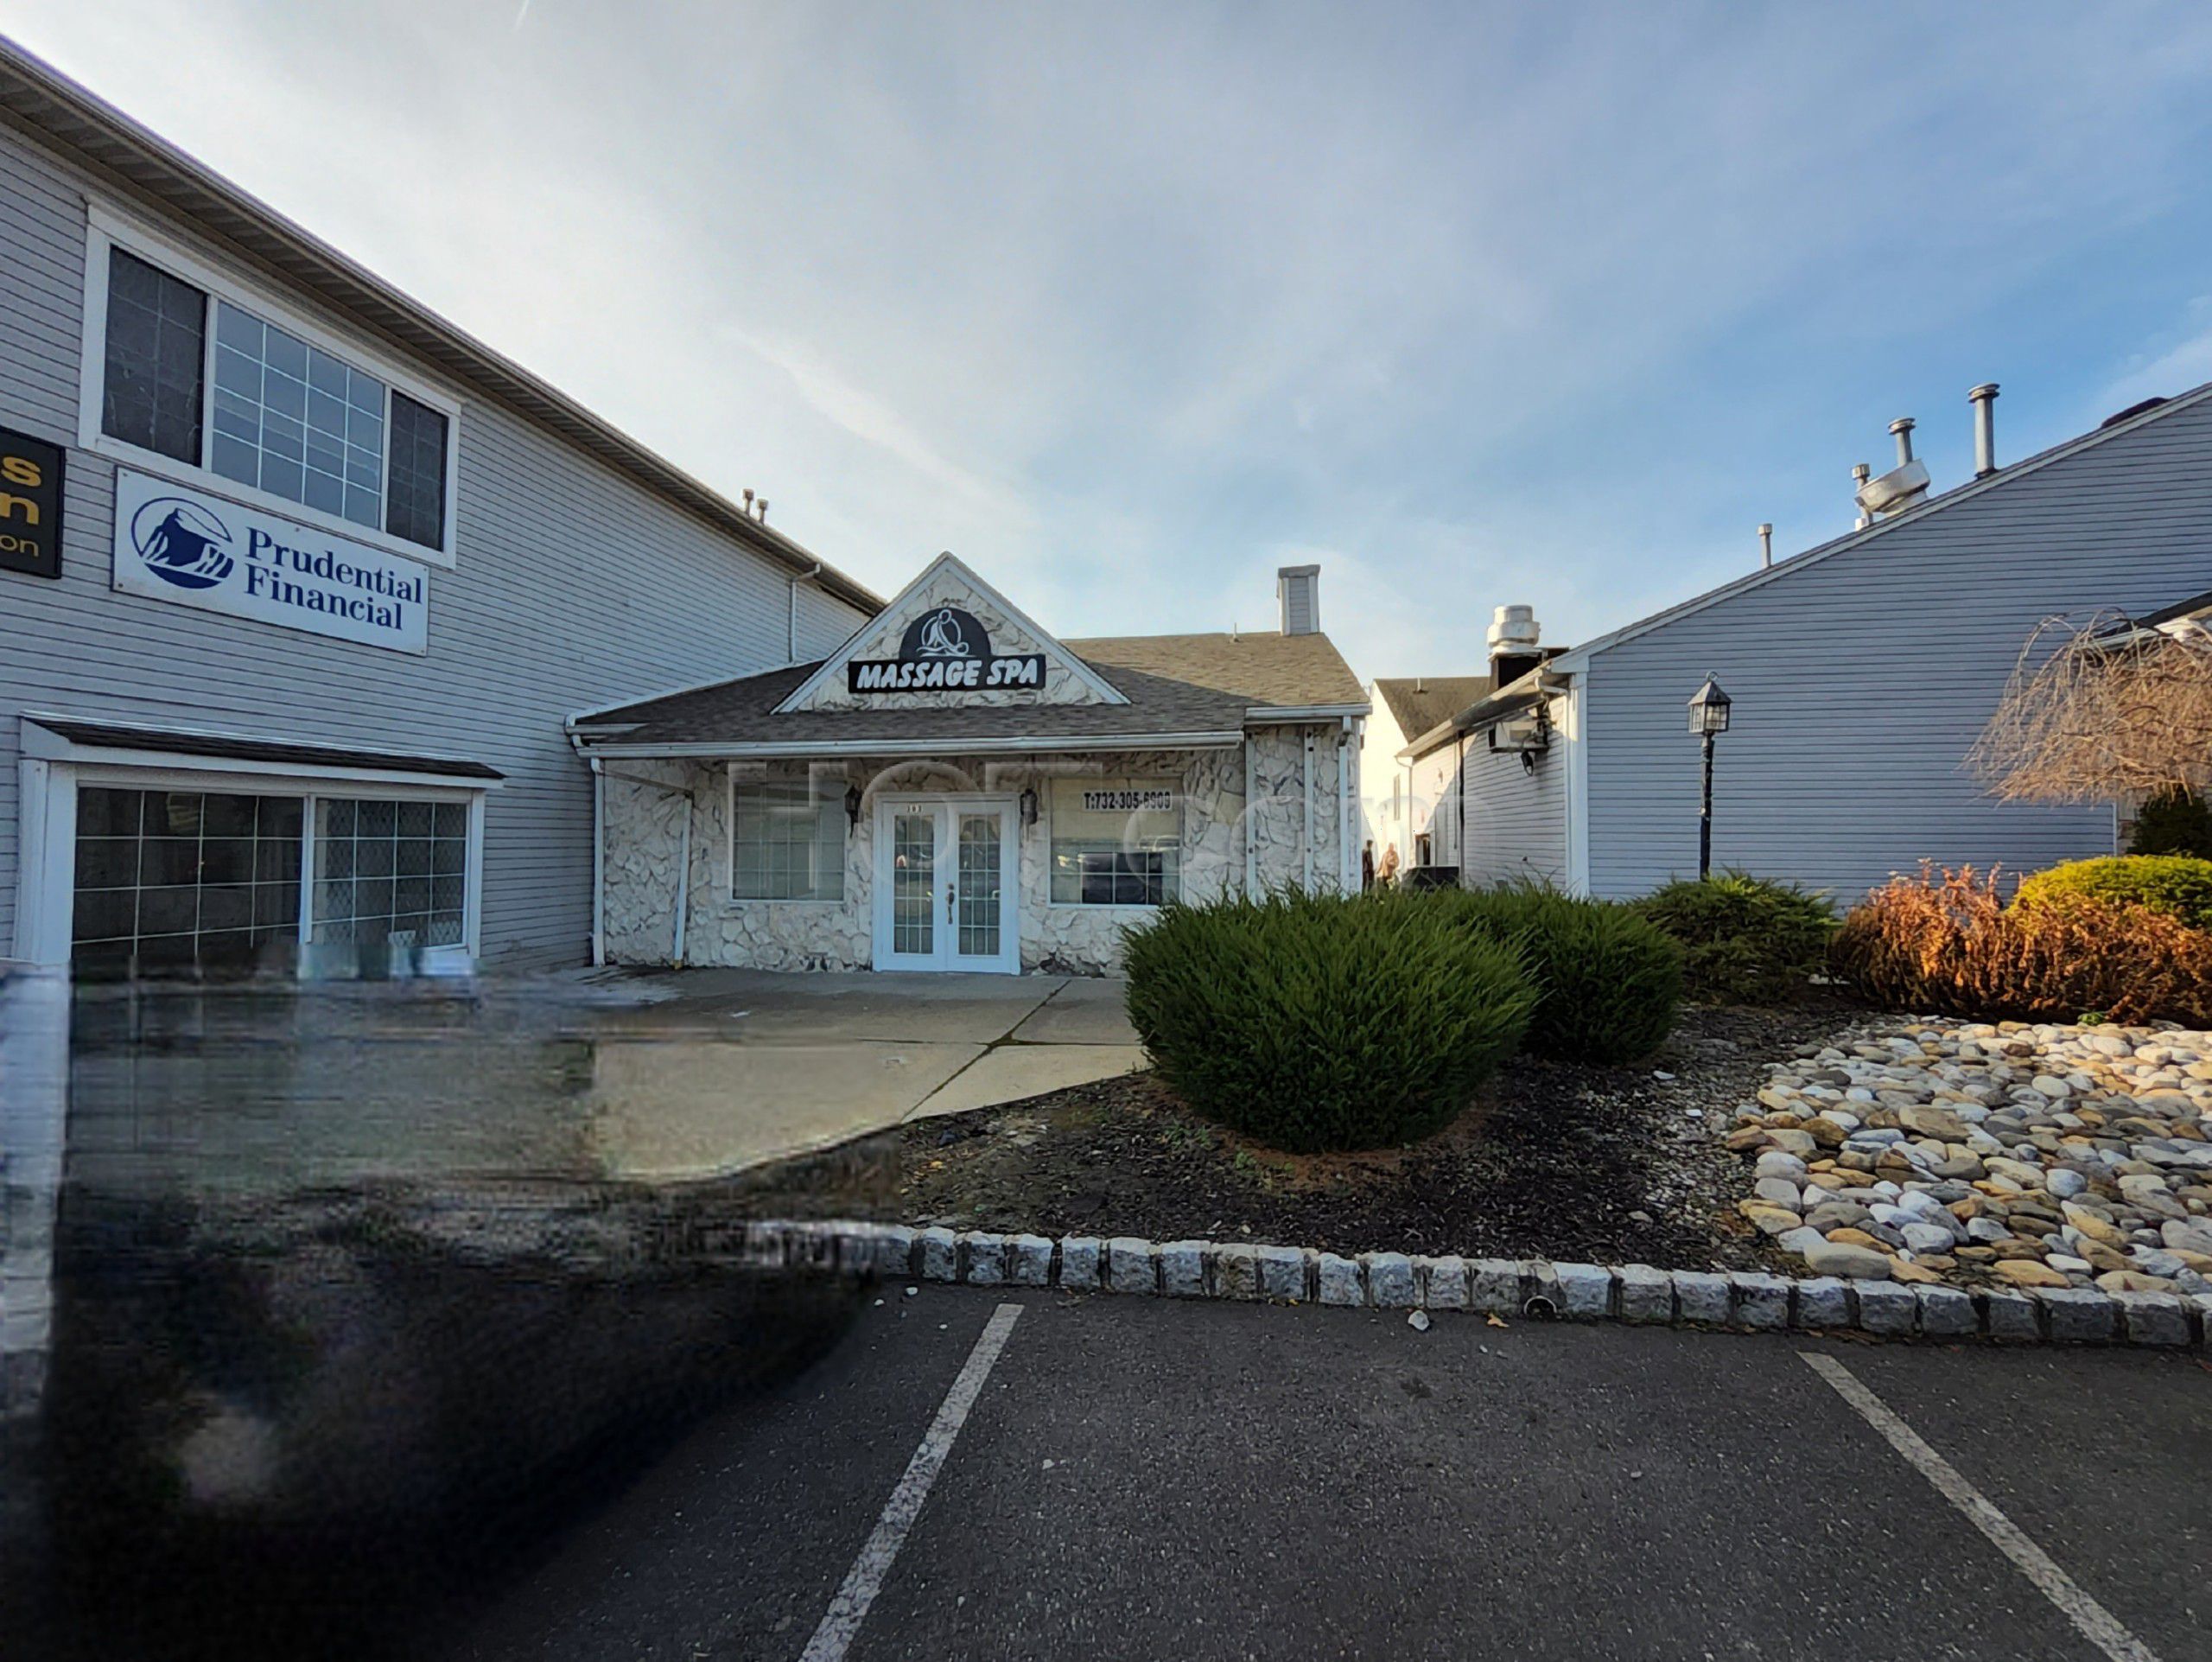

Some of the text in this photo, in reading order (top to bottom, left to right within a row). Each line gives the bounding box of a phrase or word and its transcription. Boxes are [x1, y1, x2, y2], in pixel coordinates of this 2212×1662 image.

[244, 563, 403, 631] Financial
[245, 525, 423, 605] Prudential
[856, 658, 1038, 689] MASSAGE SPA
